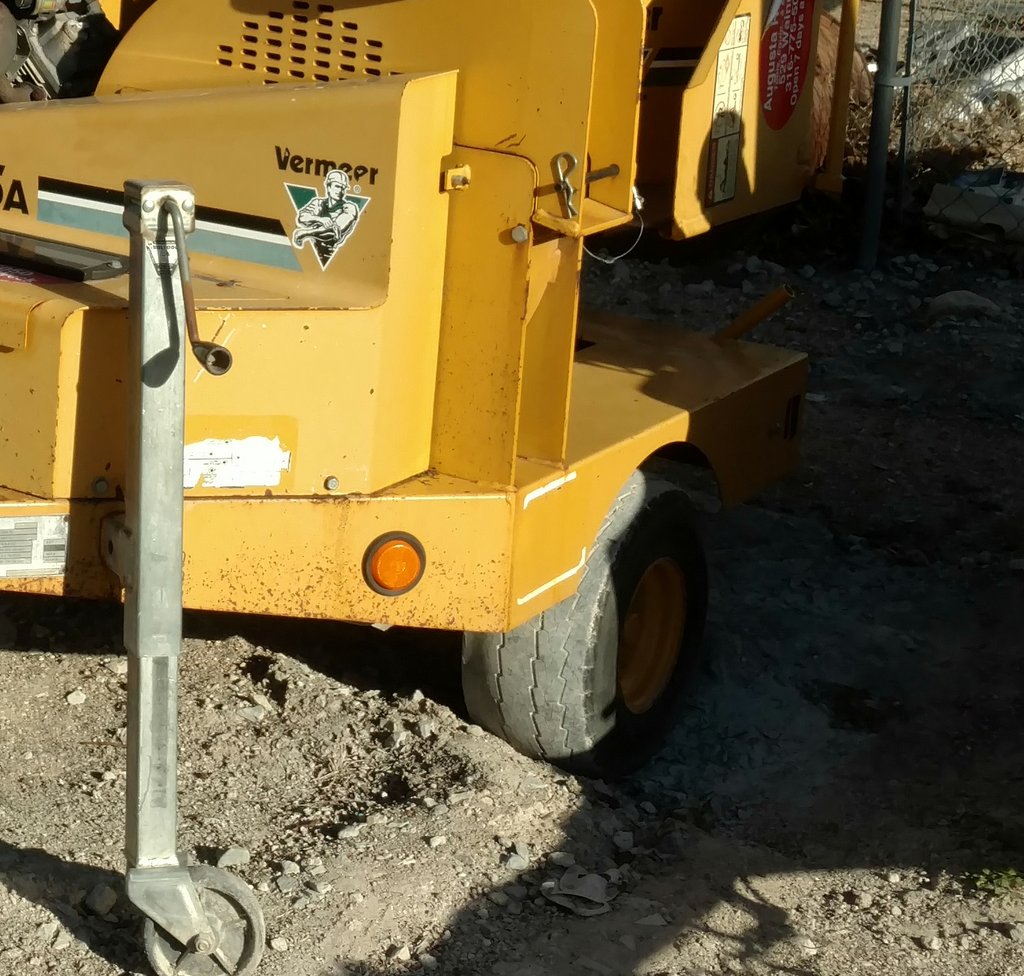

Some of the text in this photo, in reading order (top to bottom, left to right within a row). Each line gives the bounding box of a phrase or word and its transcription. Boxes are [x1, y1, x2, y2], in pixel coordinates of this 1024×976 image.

[764, 32, 777, 111] Augusta
[790, 66, 799, 105] Open
[796, 14, 804, 48] days
[274, 145, 378, 185] Vermeer
